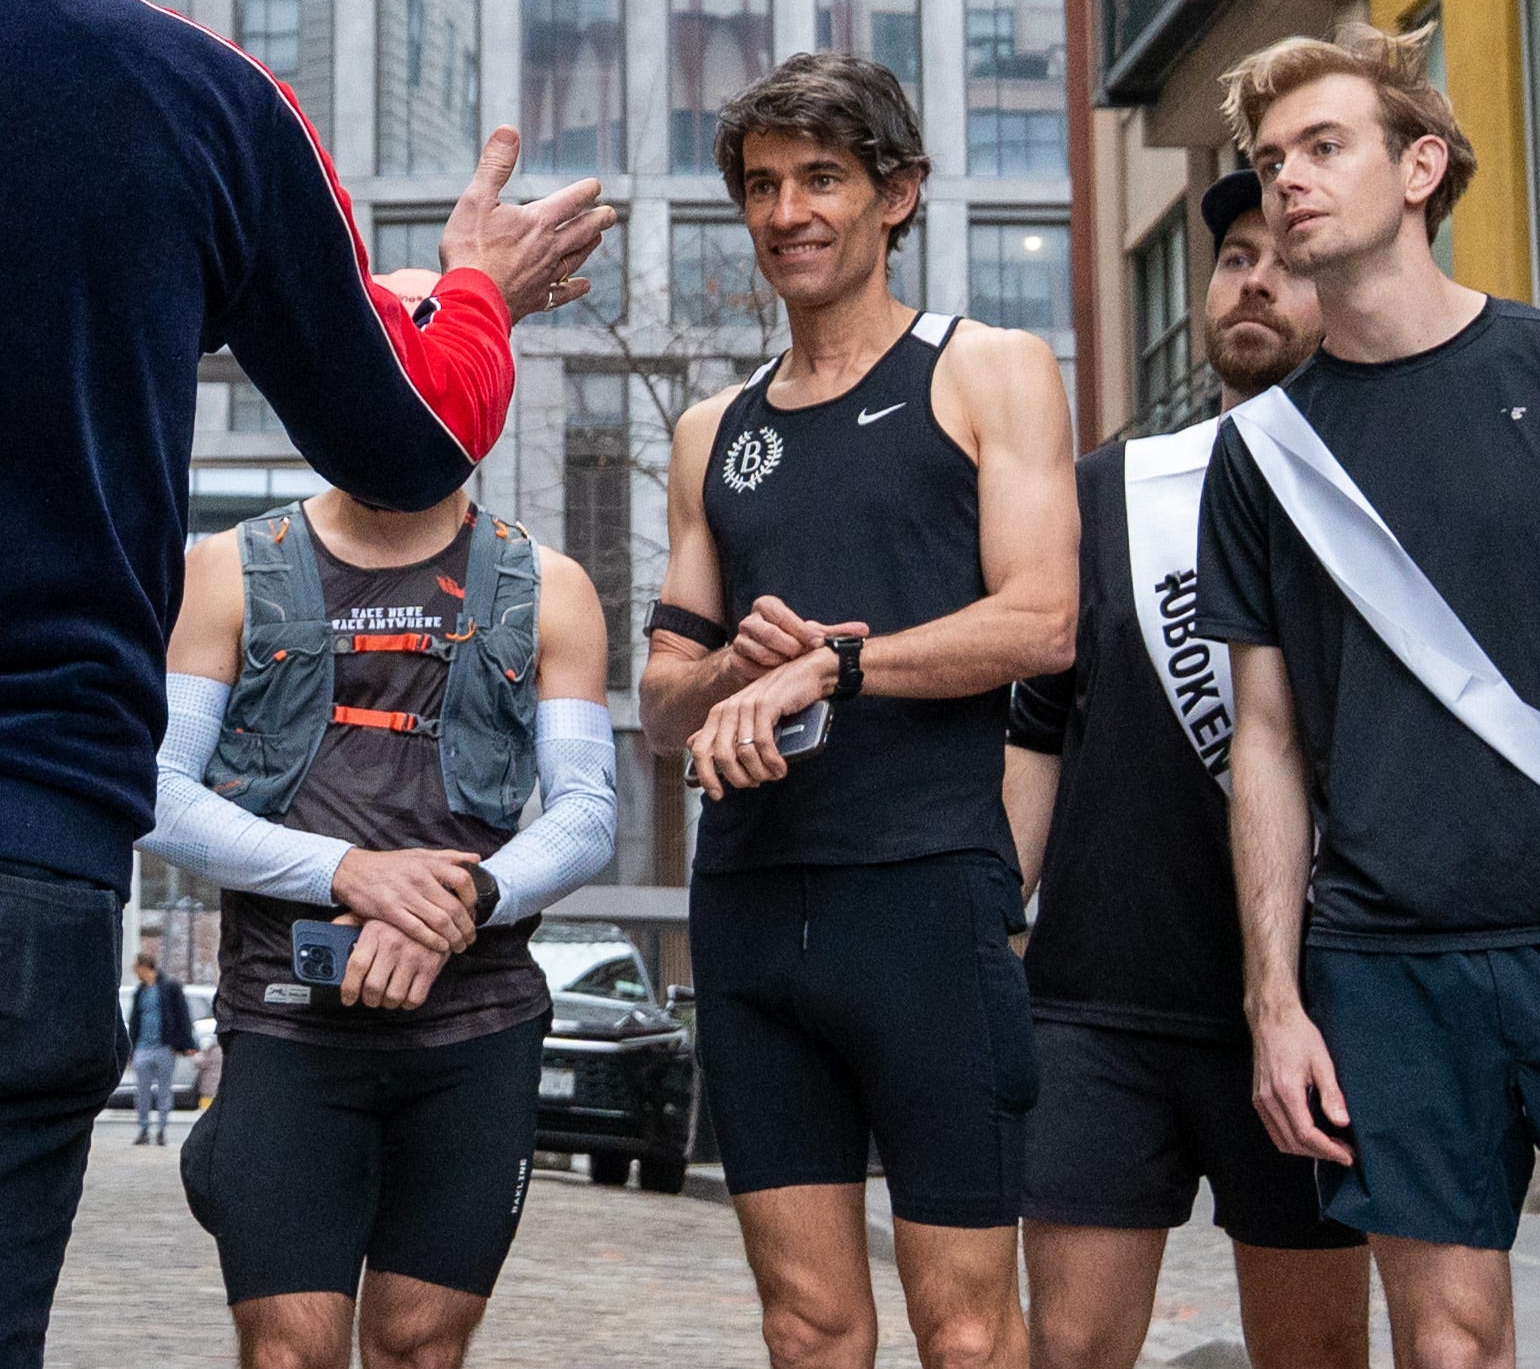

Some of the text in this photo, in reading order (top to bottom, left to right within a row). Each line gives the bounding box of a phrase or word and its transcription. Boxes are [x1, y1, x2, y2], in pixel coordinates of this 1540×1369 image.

[740, 440, 762, 474] B
[388, 606, 424, 618] HERE
[368, 616, 442, 630] ANYWHERE
